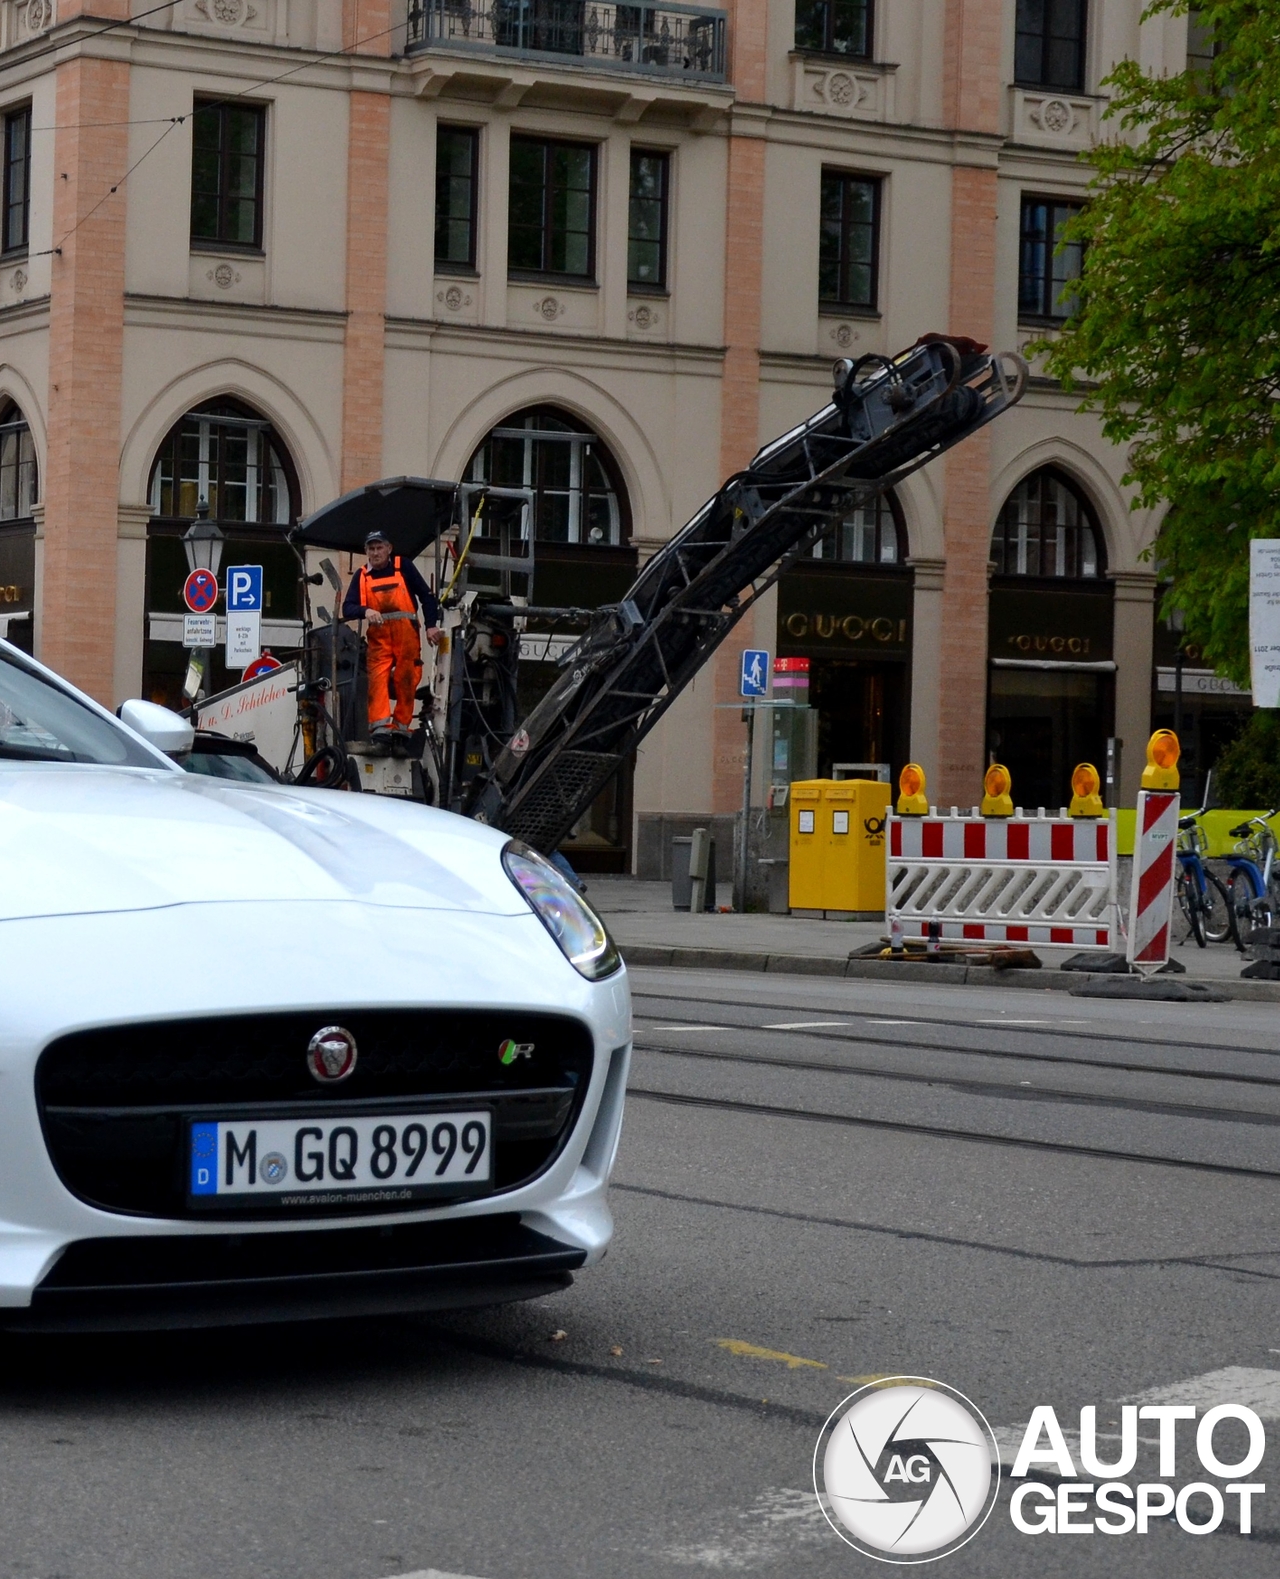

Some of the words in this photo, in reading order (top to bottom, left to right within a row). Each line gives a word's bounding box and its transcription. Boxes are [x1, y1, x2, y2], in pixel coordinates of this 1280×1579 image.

[232, 572, 252, 606] P
[187, 618, 212, 626] Feuerwehr-
[786, 612, 906, 642] GUCCI
[186, 627, 212, 635] anfahrtzone
[1017, 635, 1090, 653] GUCCI
[221, 703, 233, 720] D.
[236, 684, 287, 715] Schilcher
[511, 1043, 536, 1060] R
[225, 1130, 258, 1186] M
[294, 1126, 359, 1183] GQ
[370, 1120, 487, 1180] 8999
[197, 1168, 209, 1185] D
[281, 1188, 413, 1205] www.avalon-muenchen.de
